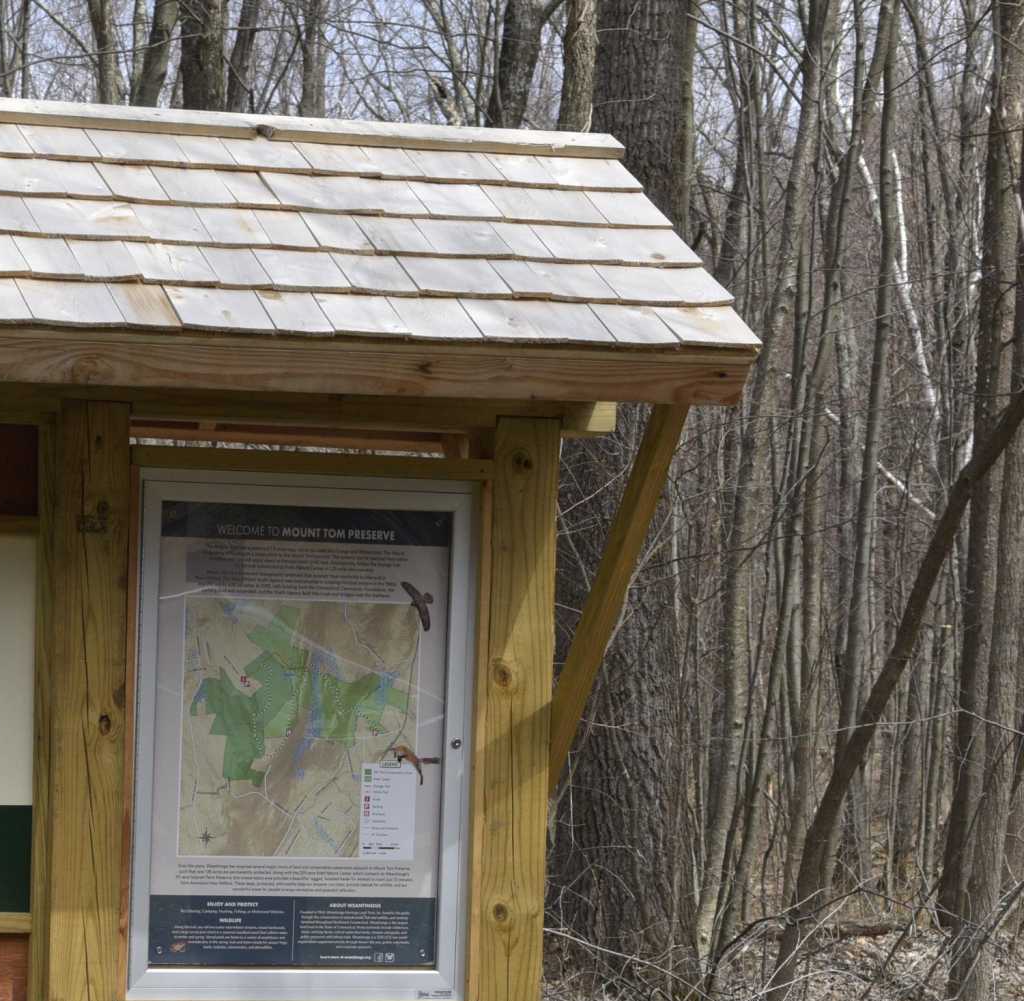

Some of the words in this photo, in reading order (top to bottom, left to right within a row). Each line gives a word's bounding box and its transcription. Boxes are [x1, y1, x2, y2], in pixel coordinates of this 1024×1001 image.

[267, 526, 280, 537] TO
[281, 527, 321, 538] MOUNT
[322, 528, 346, 539] TOM
[348, 529, 396, 541] PRESERVE
